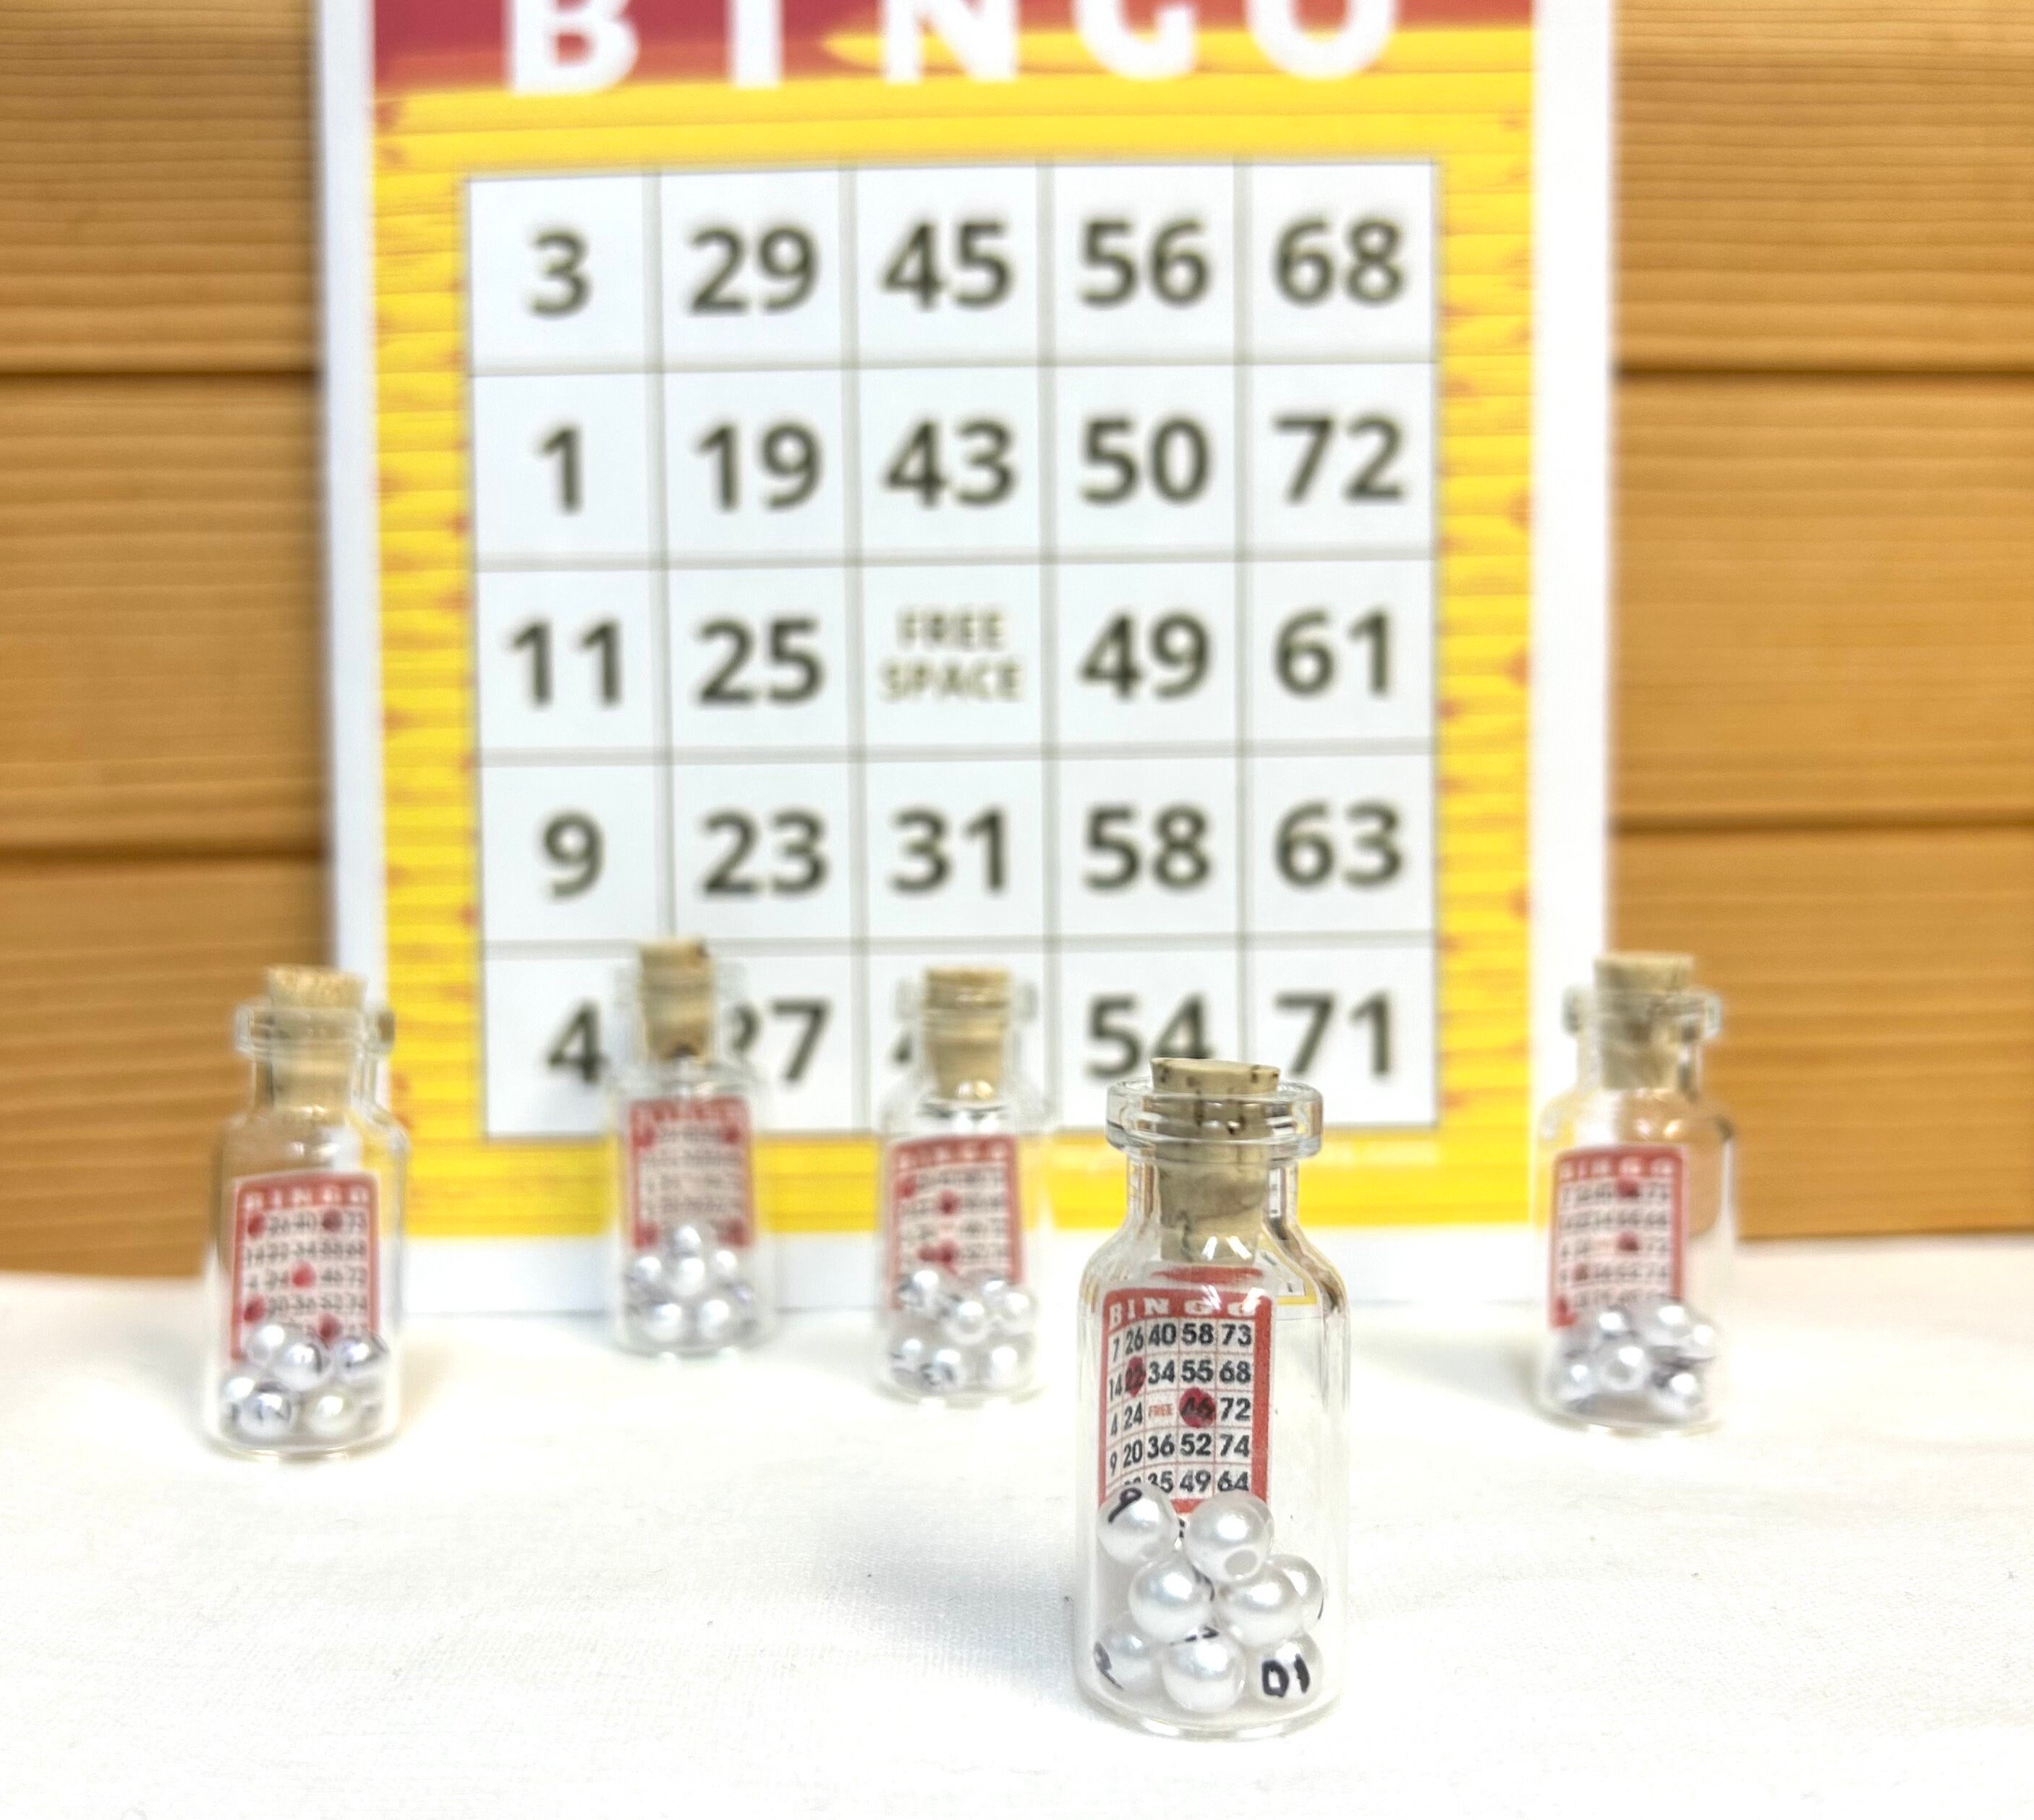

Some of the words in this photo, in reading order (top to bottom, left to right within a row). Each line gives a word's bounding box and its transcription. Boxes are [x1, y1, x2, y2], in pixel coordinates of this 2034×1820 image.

[532, 230, 590, 318] 3
[689, 224, 819, 315] 29
[882, 218, 1013, 310] 45
[1082, 218, 1211, 308] 56
[1273, 218, 1405, 305] 68
[542, 425, 582, 512] 1
[699, 421, 822, 511] 19
[884, 417, 1016, 508] 43
[1083, 415, 1212, 506] 50
[1275, 413, 1404, 503] 72
[897, 610, 1006, 652] FREE
[511, 619, 621, 706] 11
[697, 616, 825, 707] 25
[1078, 612, 1212, 699] 49
[1274, 610, 1390, 698] 61
[880, 660, 1022, 703] SPACE
[541, 811, 604, 899] 9
[700, 809, 829, 898] 23
[893, 807, 1007, 895] 31
[1085, 804, 1212, 893] 58
[1274, 801, 1404, 889] 63
[545, 998, 608, 1088] 4
[1088, 994, 1214, 1079] 54
[1276, 992, 1392, 1078] 71
[1112, 1338, 1120, 1362] 7
[1125, 1325, 1144, 1355] 26
[1148, 1322, 1177, 1346] 40
[1181, 1323, 1214, 1345] 58
[1221, 1324, 1252, 1347] 73
[1110, 1373, 1122, 1402] 14
[1147, 1360, 1175, 1385] 34
[1180, 1360, 1214, 1383] 55
[1219, 1361, 1251, 1384] 68
[1110, 1413, 1118, 1437] 4
[1123, 1401, 1143, 1431] 24
[1147, 1403, 1173, 1419] FREE
[1220, 1397, 1251, 1421] 72
[1110, 1452, 1118, 1476] 9
[1123, 1439, 1143, 1469] 20
[1147, 1434, 1175, 1459] 36
[1180, 1433, 1212, 1457] 52
[1219, 1433, 1251, 1458] 74
[1179, 1469, 1212, 1493] 49
[1217, 1470, 1249, 1492] 64
